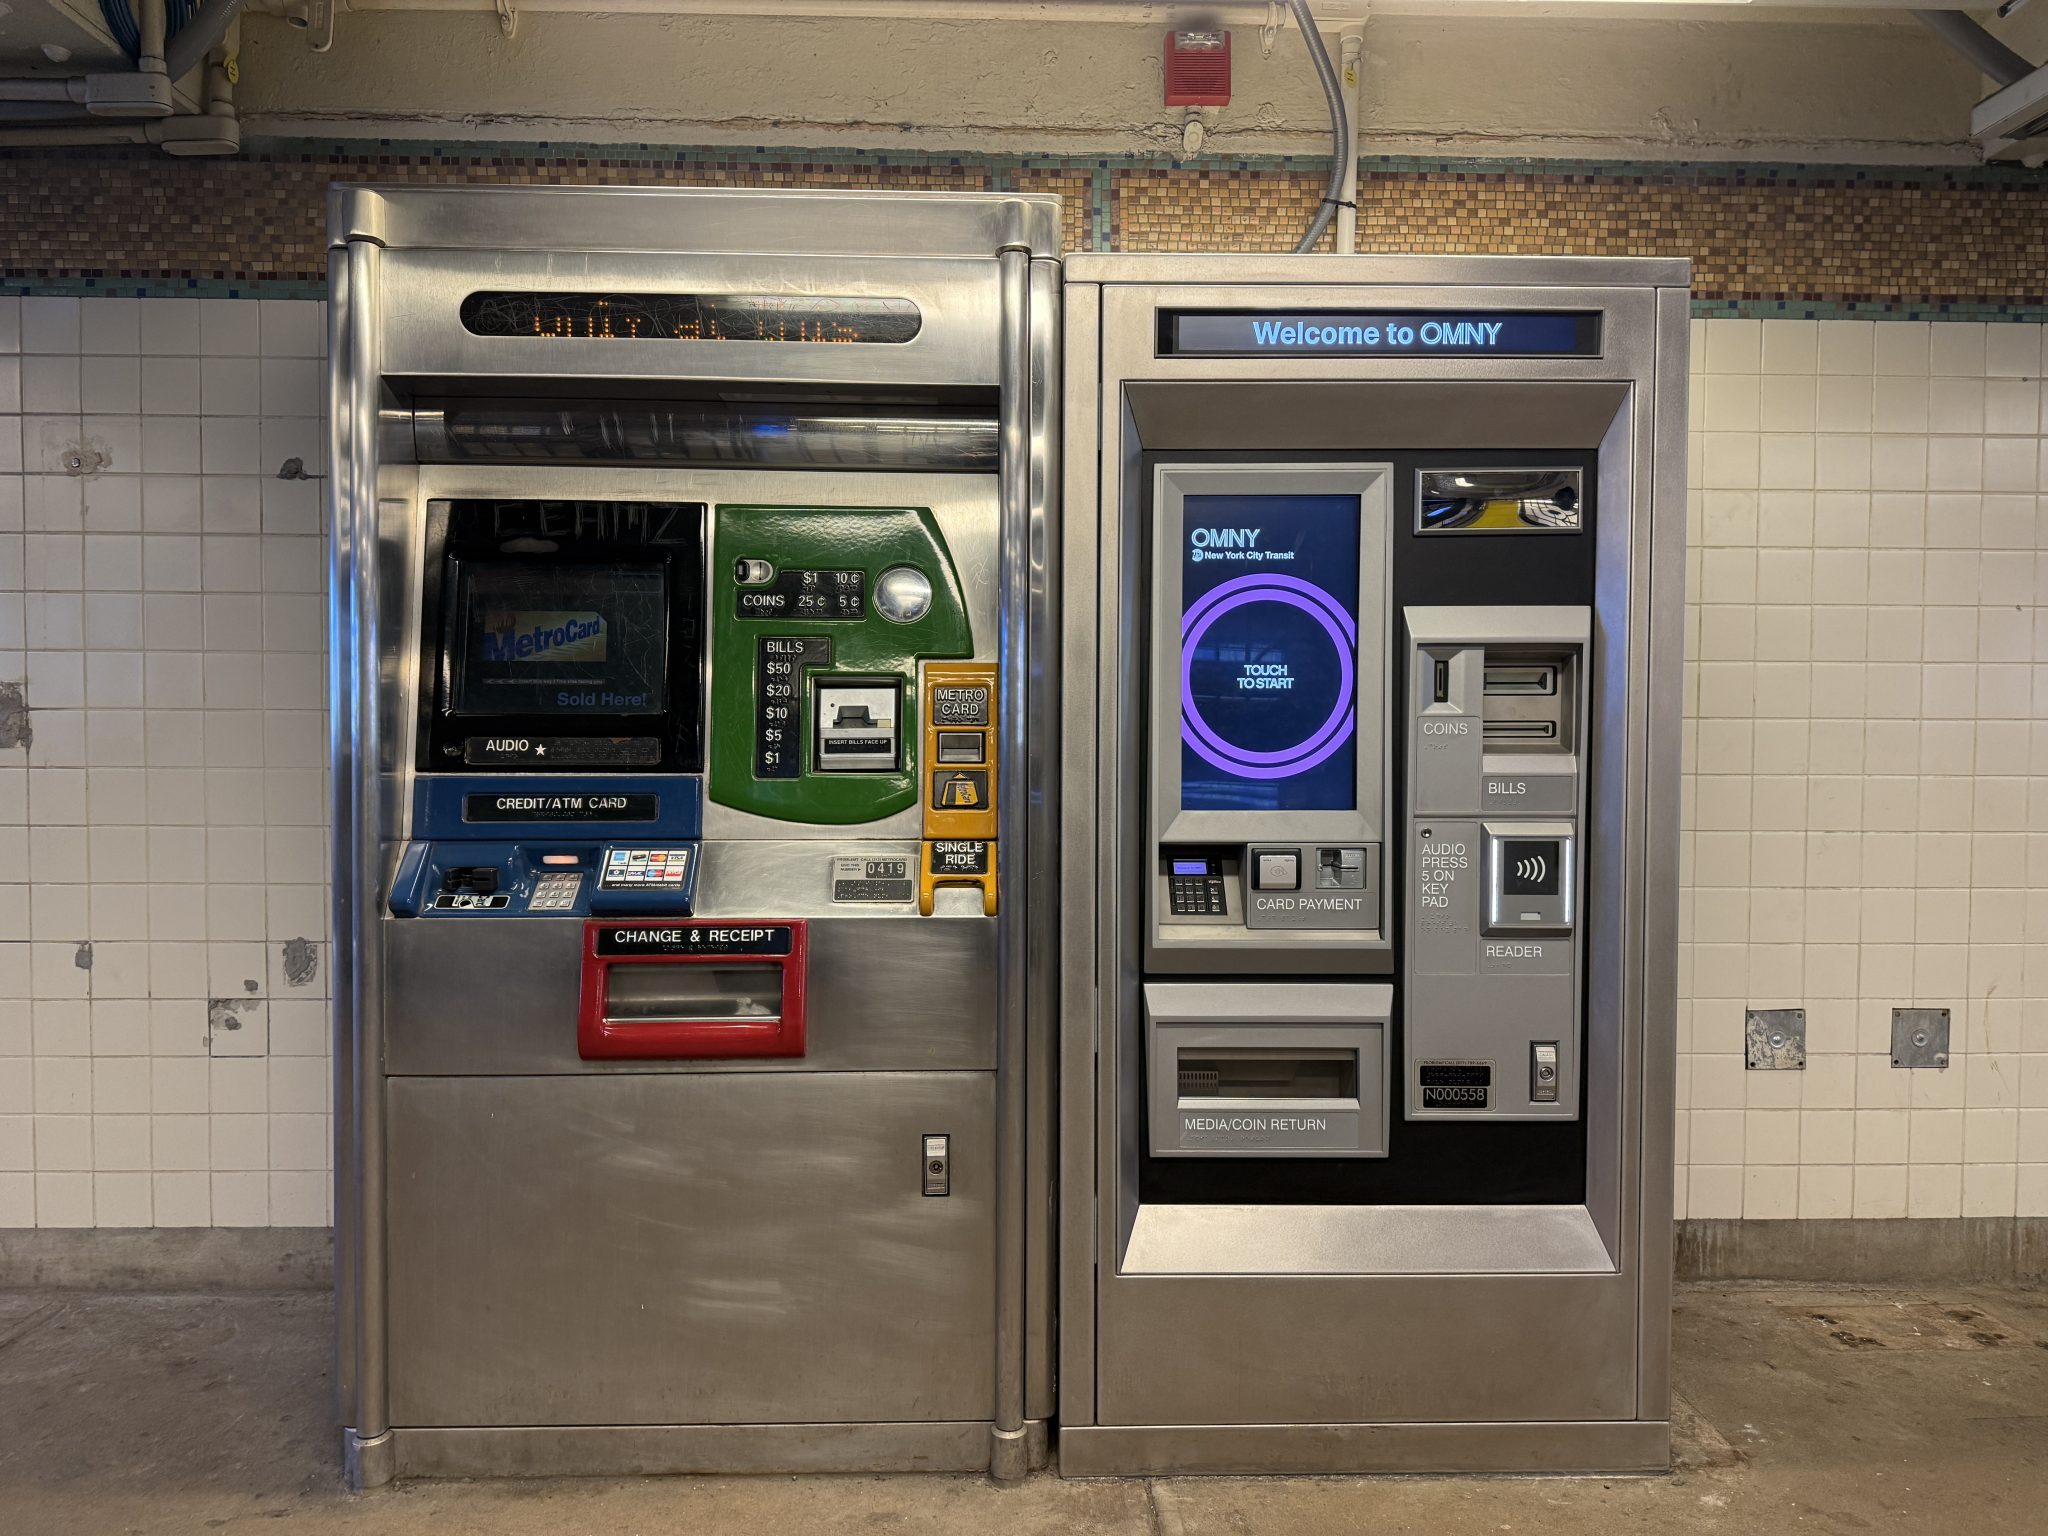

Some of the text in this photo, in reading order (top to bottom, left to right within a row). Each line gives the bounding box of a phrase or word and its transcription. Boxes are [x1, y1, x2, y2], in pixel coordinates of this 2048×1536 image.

[1253, 321, 1503, 346] Welcome to OMNY
[1191, 527, 1261, 548] OMNY
[1204, 551, 1224, 560] New
[1225, 551, 1245, 560] York
[1246, 551, 1264, 561] City
[1265, 551, 1295, 560] Transit
[803, 571, 860, 585] $1 10 ¢
[743, 595, 860, 608] COINS 25 ¢ 5 ¢
[483, 615, 601, 661] MetroCard
[766, 641, 804, 653] BILLS
[766, 662, 791, 675] $50
[1244, 664, 1288, 677] TOUCH
[1237, 677, 1295, 690] TO START
[766, 684, 790, 698] $20
[936, 689, 985, 701] METRO
[556, 692, 648, 707] Sold Here!
[766, 707, 788, 719] $10
[941, 703, 979, 715] CARD
[765, 729, 782, 742] $5
[1423, 723, 1468, 736] COINS
[486, 739, 529, 752] AUDIO
[765, 751, 780, 765] $1
[1488, 782, 1526, 795] BILLS
[496, 797, 628, 810] CREDIT/ATM CARD
[936, 842, 984, 853] SINGLE
[1422, 844, 1465, 856] AUDIO
[945, 854, 976, 865] RIDE
[1422, 857, 1468, 869] PRESS
[867, 862, 905, 874] 0419
[1422, 870, 1455, 882] 5 ON
[1422, 883, 1449, 895] KEY
[1256, 898, 1362, 911] CARD PAYMENT
[1422, 896, 1449, 908] PAD
[614, 929, 775, 944] CHANGE & RECEIPT
[1486, 945, 1542, 958] READER
[1426, 1087, 1485, 1102] N000558
[1184, 1117, 1327, 1132] MEDIA/COIN RETURN
